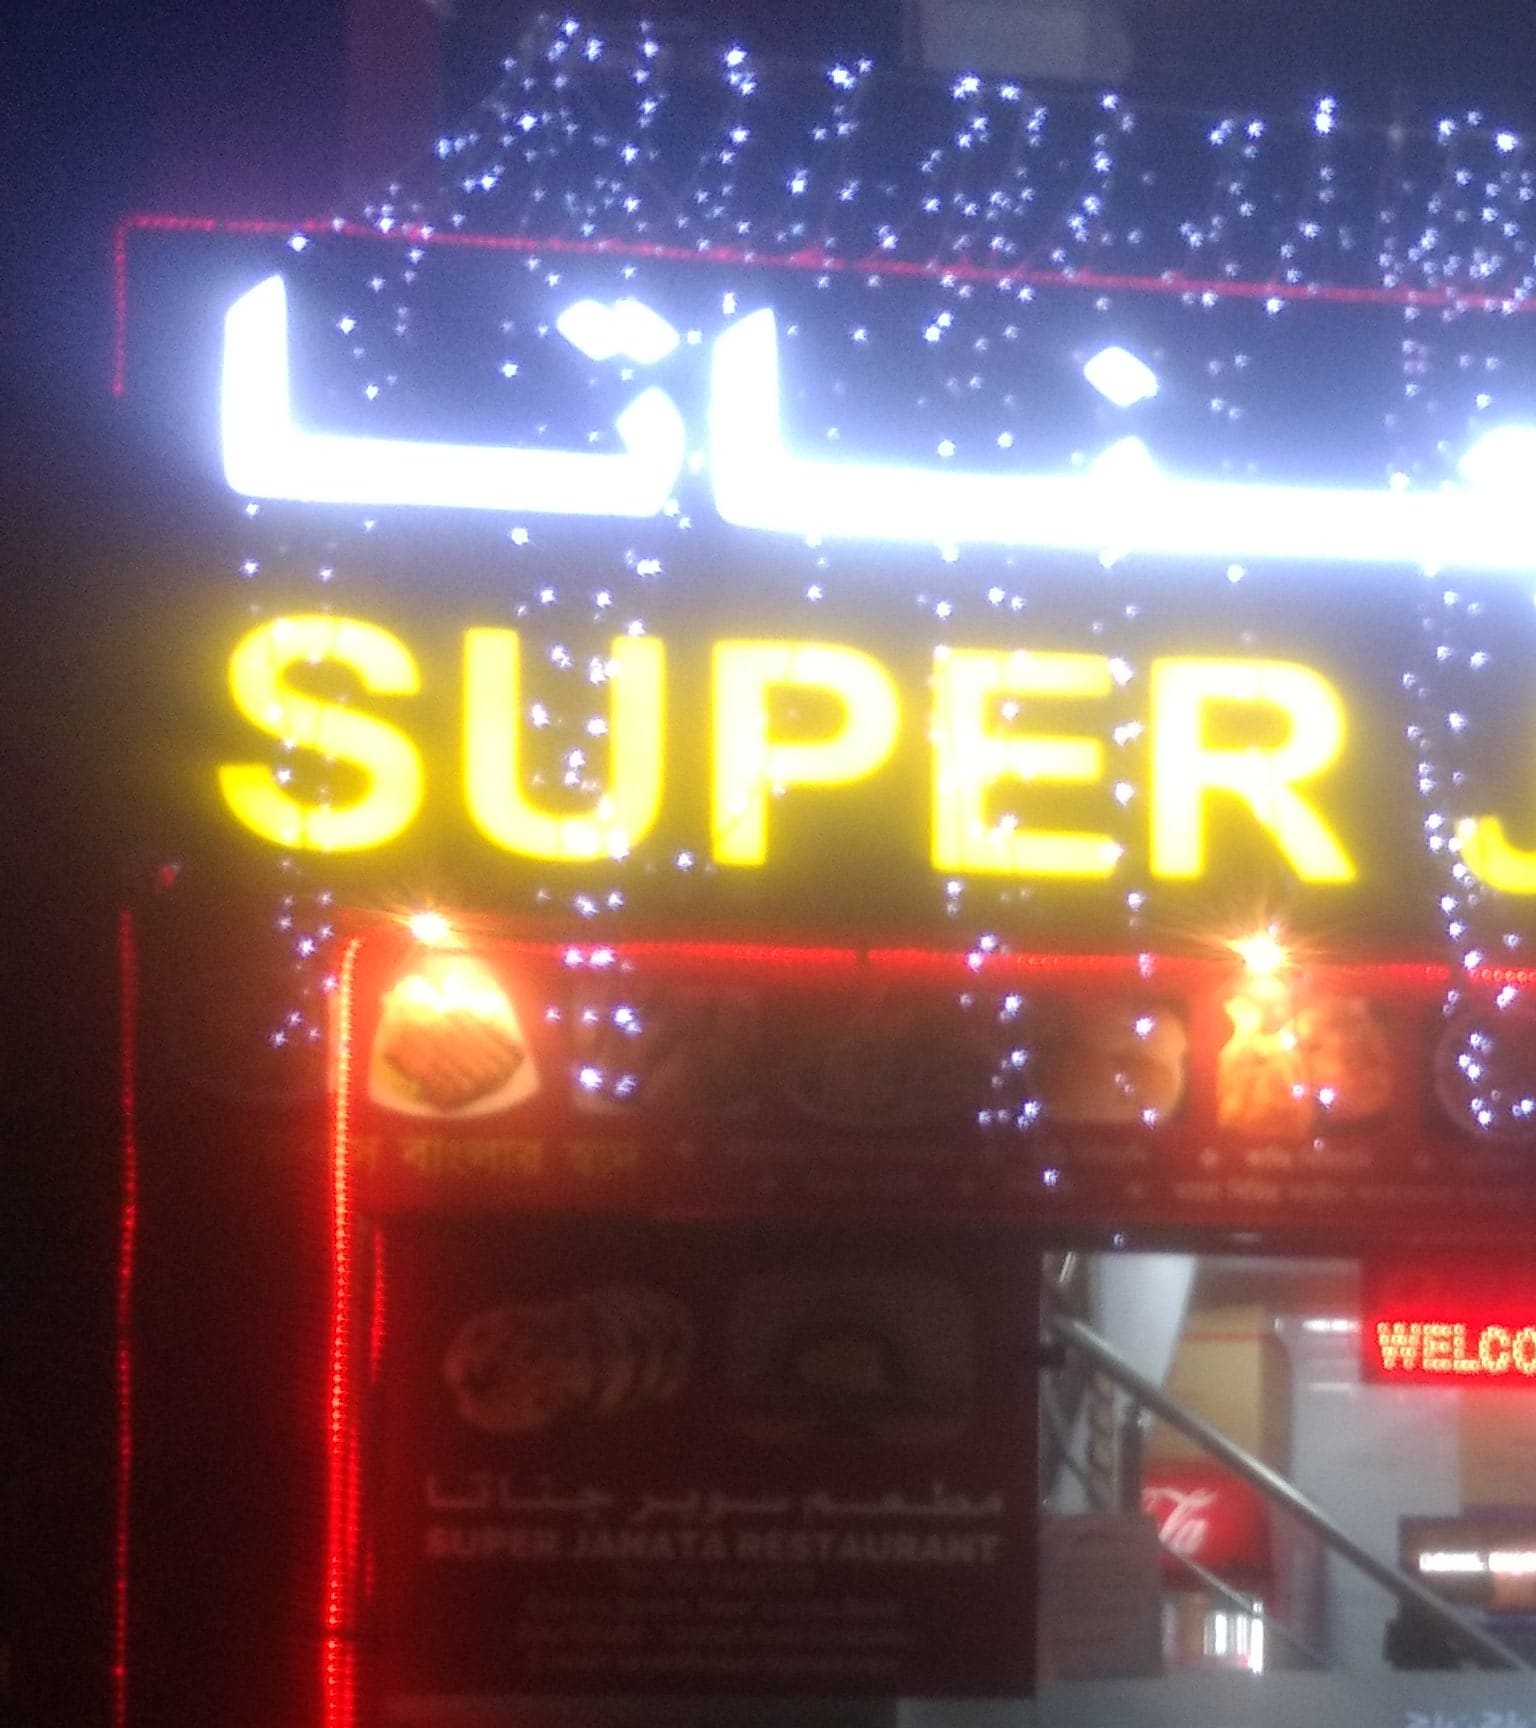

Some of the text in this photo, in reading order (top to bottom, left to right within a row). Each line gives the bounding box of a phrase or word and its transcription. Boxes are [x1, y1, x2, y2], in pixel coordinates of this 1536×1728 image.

[217, 612, 1361, 891] SUPER
[424, 1526, 1002, 1564] SUPER JANATA RESTAURANT
